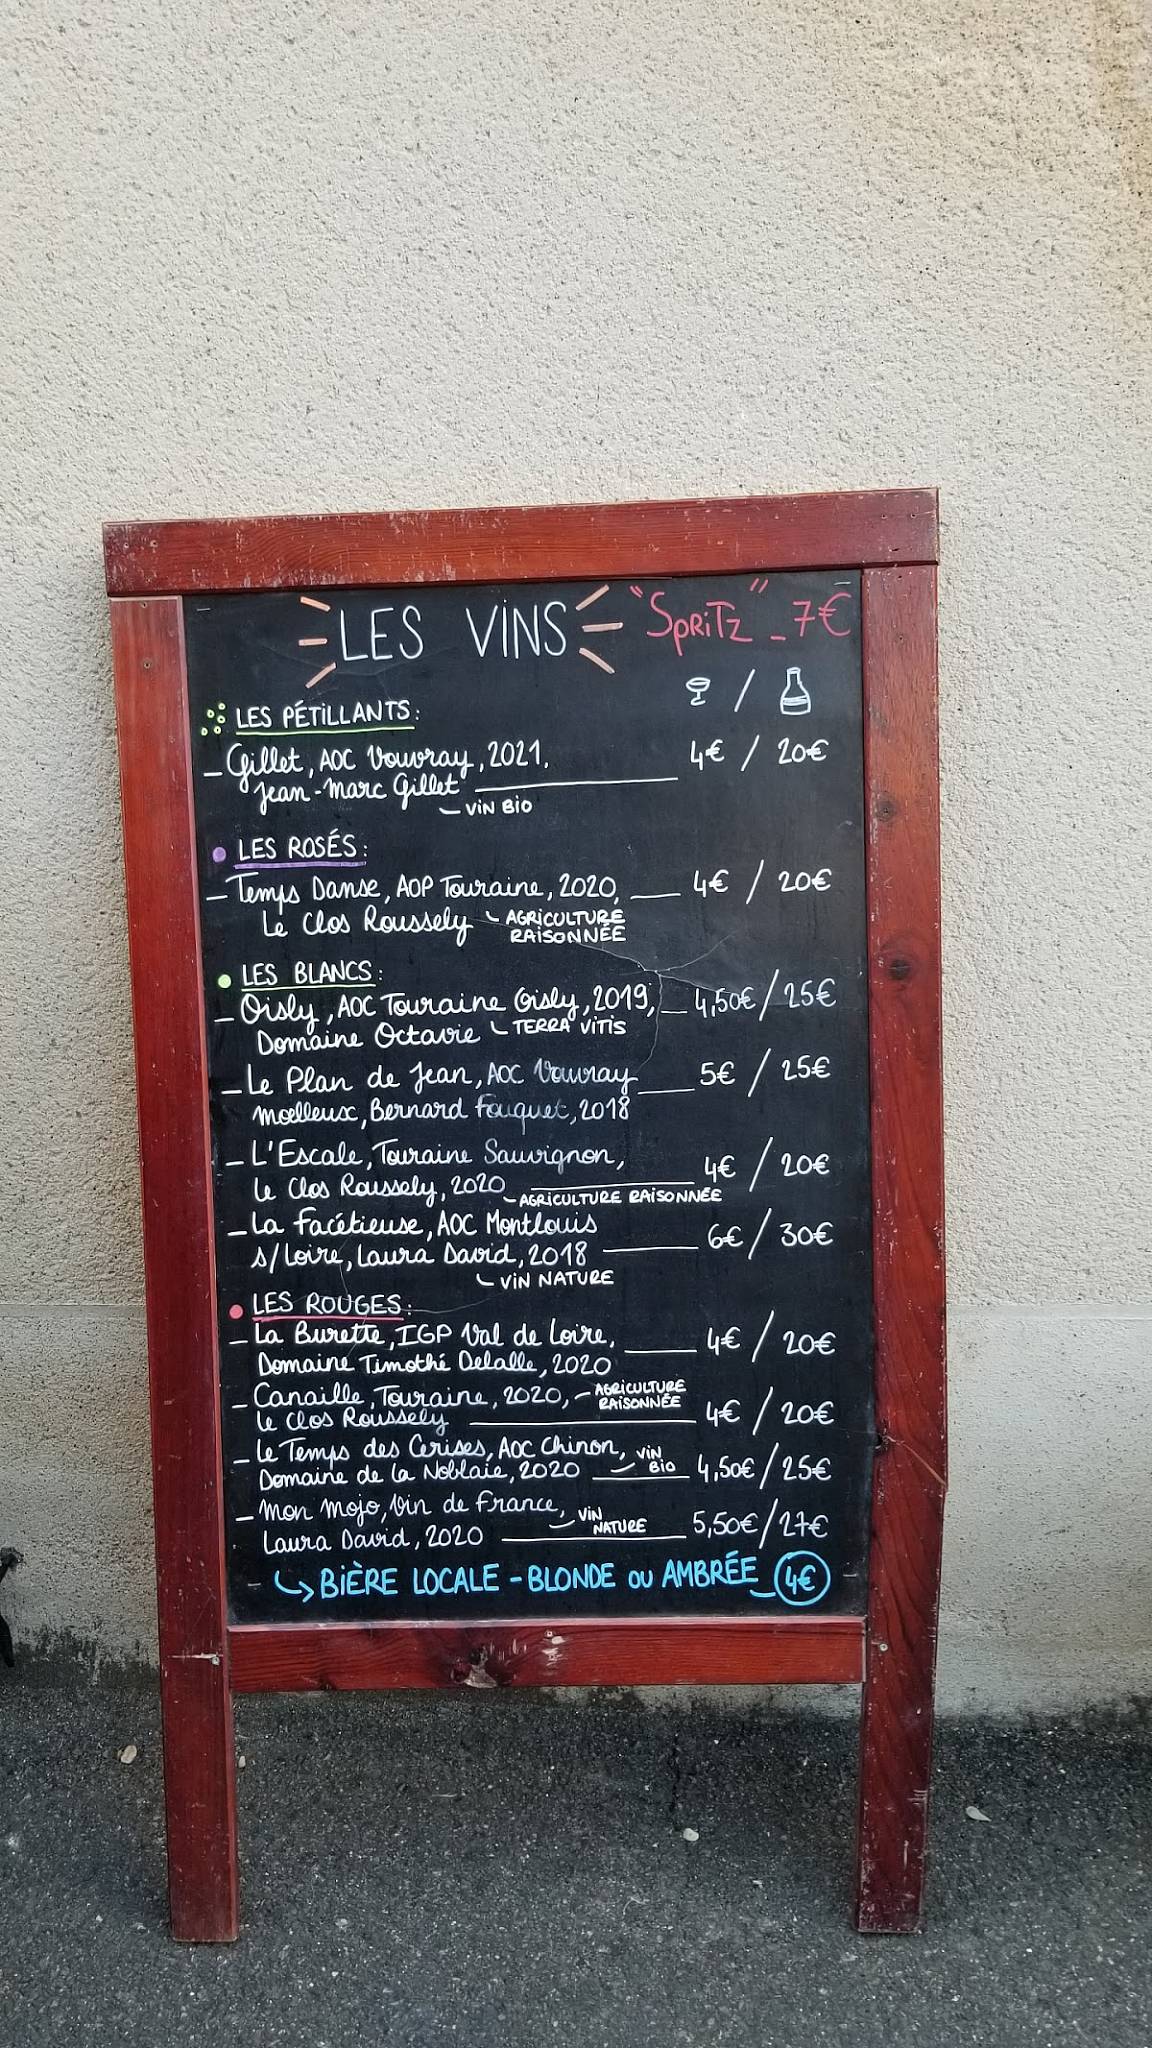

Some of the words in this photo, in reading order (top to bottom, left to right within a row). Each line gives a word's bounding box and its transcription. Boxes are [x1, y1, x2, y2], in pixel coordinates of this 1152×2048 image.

[340, 605, 424, 661] LES
[236, 706, 272, 728] LES
[319, 749, 356, 770] AOC
[690, 739, 725, 771] 4€
[778, 737, 829, 765] 20€
[393, 773, 460, 810] Gillet
[239, 837, 277, 861] LES
[225, 872, 300, 915] Temps
[396, 873, 434, 898] AOP
[693, 869, 729, 898] 4€
[778, 869, 832, 893] 20€
[263, 910, 288, 938] Le
[303, 910, 350, 935] Clos
[364, 904, 474, 947] Roussely
[242, 964, 277, 986] LES
[337, 995, 376, 1018] AOC
[380, 992, 507, 1016] Touraine
[784, 978, 837, 1009] 25€
[257, 1029, 364, 1055] Domaine
[375, 1022, 481, 1050] Octavie
[248, 1063, 274, 1096] Le
[287, 1066, 353, 1094] Plan
[367, 1064, 400, 1088] de
[487, 1061, 524, 1086] AOC
[534, 1058, 639, 1095] Vouvray
[700, 1061, 735, 1086] 5€
[781, 1056, 831, 1081] 25€
[370, 1097, 472, 1122] Bernard
[579, 1096, 631, 1121] 2018
[372, 1138, 472, 1165] Touraine
[704, 1155, 736, 1183] 4€
[781, 1153, 830, 1177] 20€
[288, 1176, 330, 1200] Clos
[450, 1172, 506, 1194] 2020
[252, 1210, 284, 1235] La
[437, 1210, 477, 1236] AOC
[486, 1208, 598, 1236] Montlouis
[707, 1223, 744, 1250] 6€
[779, 1221, 834, 1247] 30€
[358, 1244, 435, 1267] Laura
[528, 1241, 587, 1266] 2018
[539, 1270, 614, 1288] NATURE
[253, 1291, 294, 1316] LES
[255, 1322, 284, 1344] La
[395, 1324, 452, 1346] IGP
[461, 1322, 504, 1346] Val
[514, 1321, 543, 1346] de
[706, 1327, 741, 1355] 4€
[783, 1330, 836, 1355] 20€
[258, 1352, 355, 1376] Domaine
[359, 1353, 451, 1374] Timothé
[553, 1354, 612, 1375] 2020
[286, 1412, 334, 1431] Clos
[343, 1407, 449, 1435] Roussely
[706, 1400, 740, 1427] 4€
[781, 1401, 835, 1425] 20€
[278, 1436, 350, 1471] Temps
[363, 1438, 400, 1460] des
[498, 1436, 535, 1460] AOC
[782, 1454, 832, 1481] 25€
[260, 1468, 348, 1491] Domaine
[357, 1463, 384, 1484] de
[392, 1463, 415, 1482] la
[520, 1460, 580, 1480] 2020
[443, 1492, 470, 1512] de
[593, 1518, 647, 1535] NATURE
[779, 1511, 829, 1538] 27€
[263, 1530, 332, 1555] Laura
[426, 1524, 483, 1548] 2020
[414, 1564, 500, 1595] LOCALE
[528, 1562, 616, 1593] BLONDE
[662, 1550, 758, 1588] AMBRÉE
[785, 1564, 816, 1595] 4€
